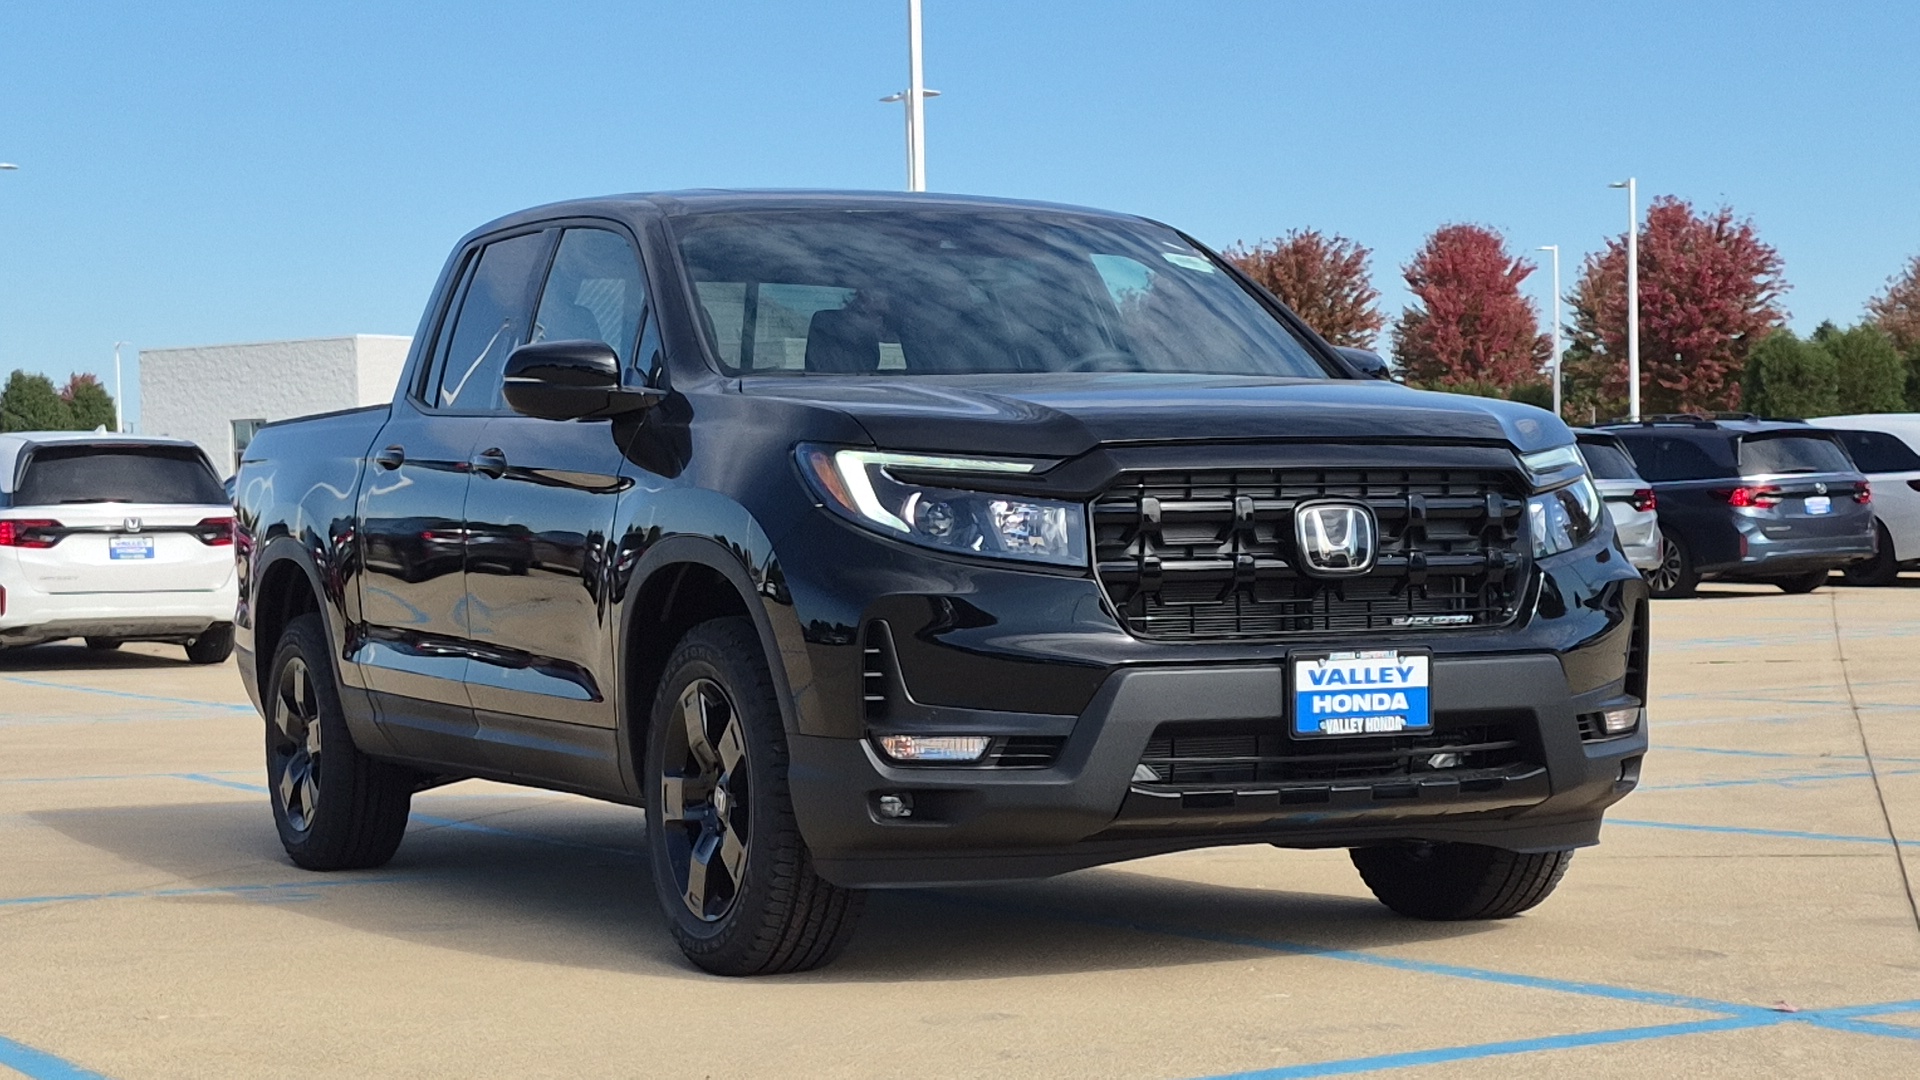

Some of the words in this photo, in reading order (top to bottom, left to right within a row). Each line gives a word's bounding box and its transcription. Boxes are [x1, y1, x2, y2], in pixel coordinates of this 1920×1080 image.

[1307, 665, 1415, 686] VALLEY
[1312, 692, 1410, 714] HONDA
[1325, 717, 1364, 734] VALLEY
[1365, 715, 1402, 732] HONDA
